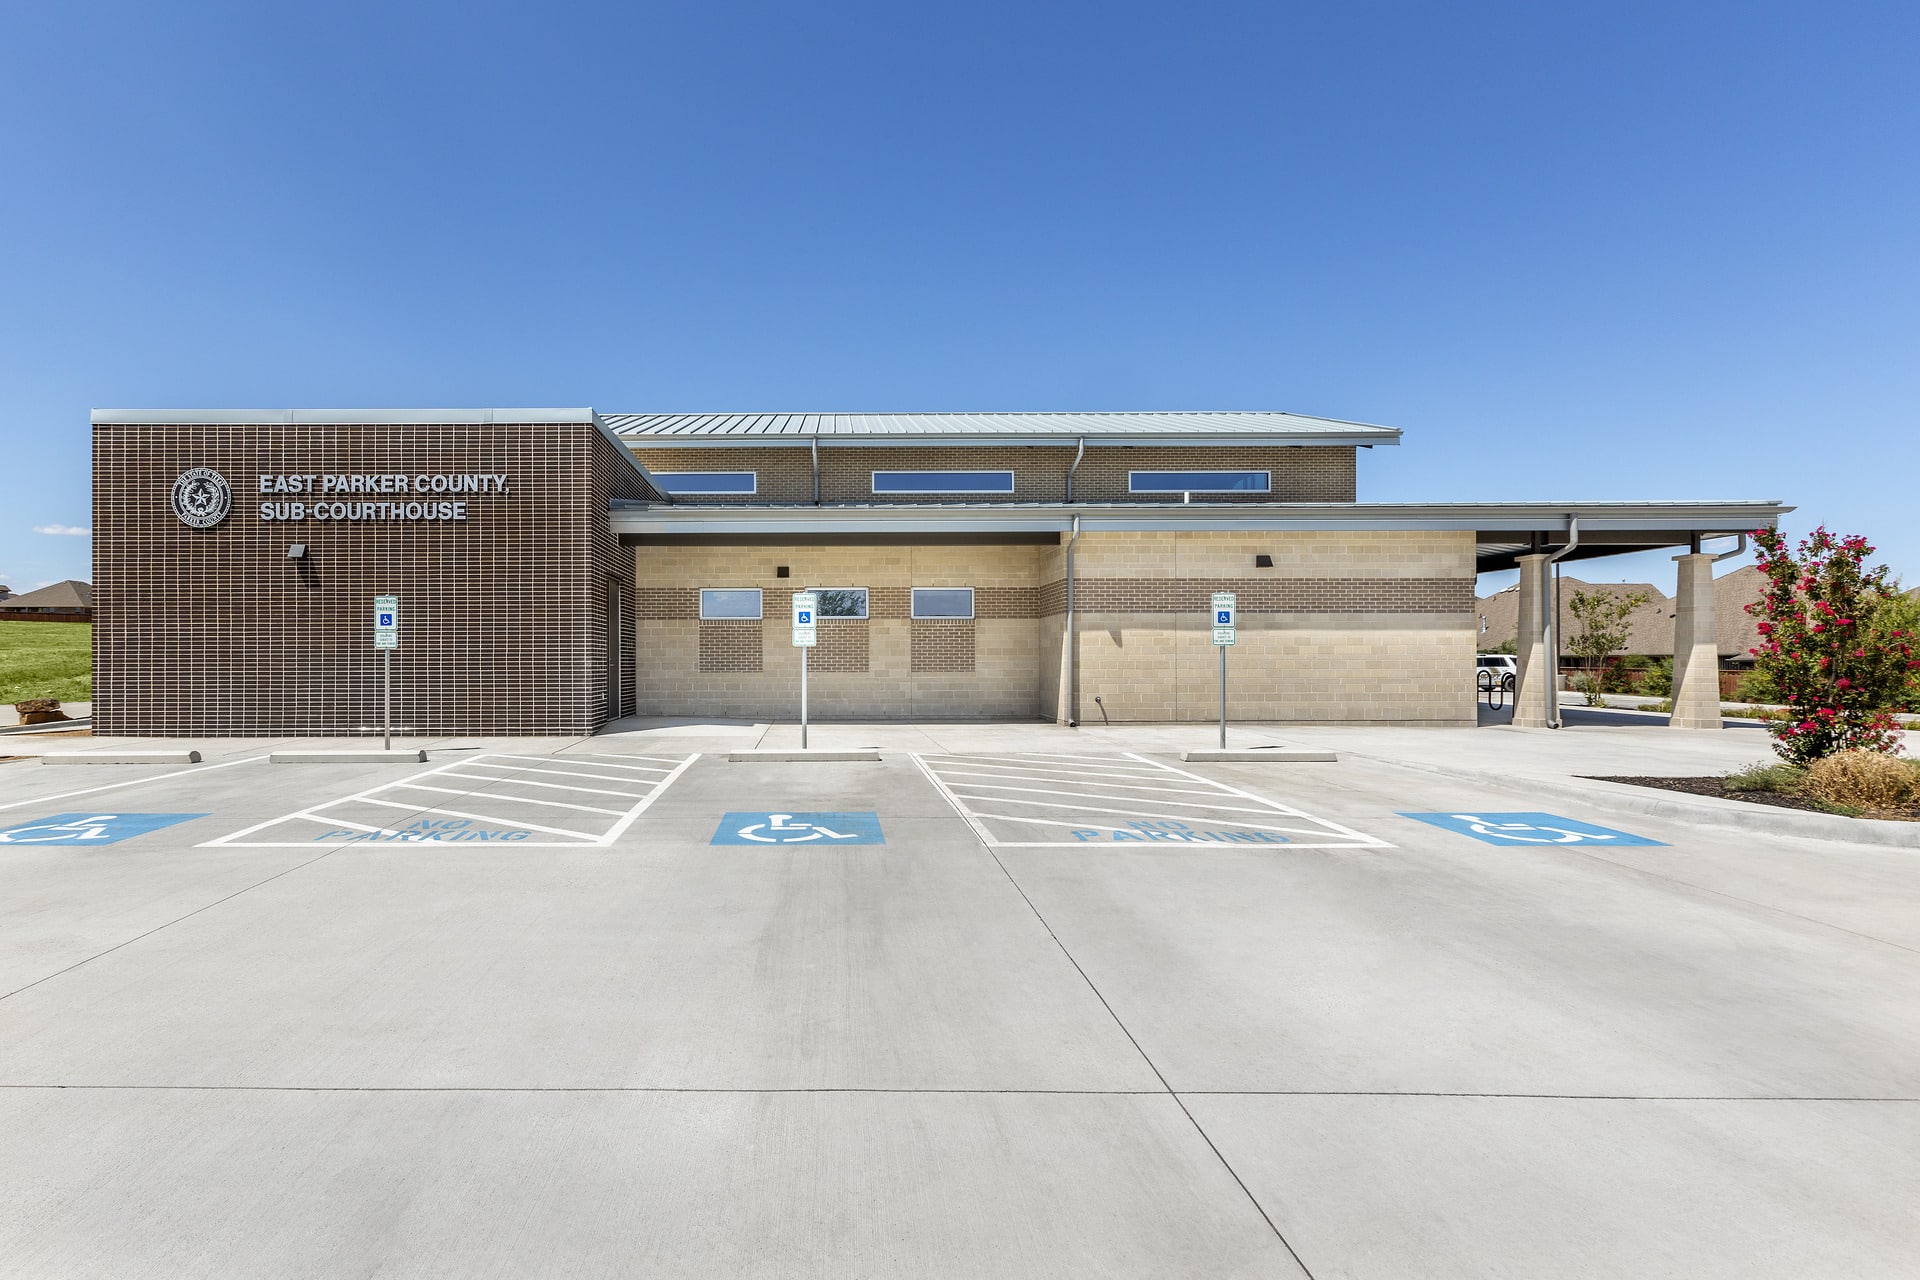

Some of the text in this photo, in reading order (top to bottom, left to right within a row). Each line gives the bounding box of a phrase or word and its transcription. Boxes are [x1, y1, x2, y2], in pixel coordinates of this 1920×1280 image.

[260, 475, 510, 495] EAST PARKER COUNTY,
[260, 502, 467, 520] SUB-COURTHOUSE
[408, 820, 473, 829] NO
[1126, 821, 1189, 830] NO
[314, 830, 532, 841] PARKING
[1071, 830, 1290, 843] PARKING
